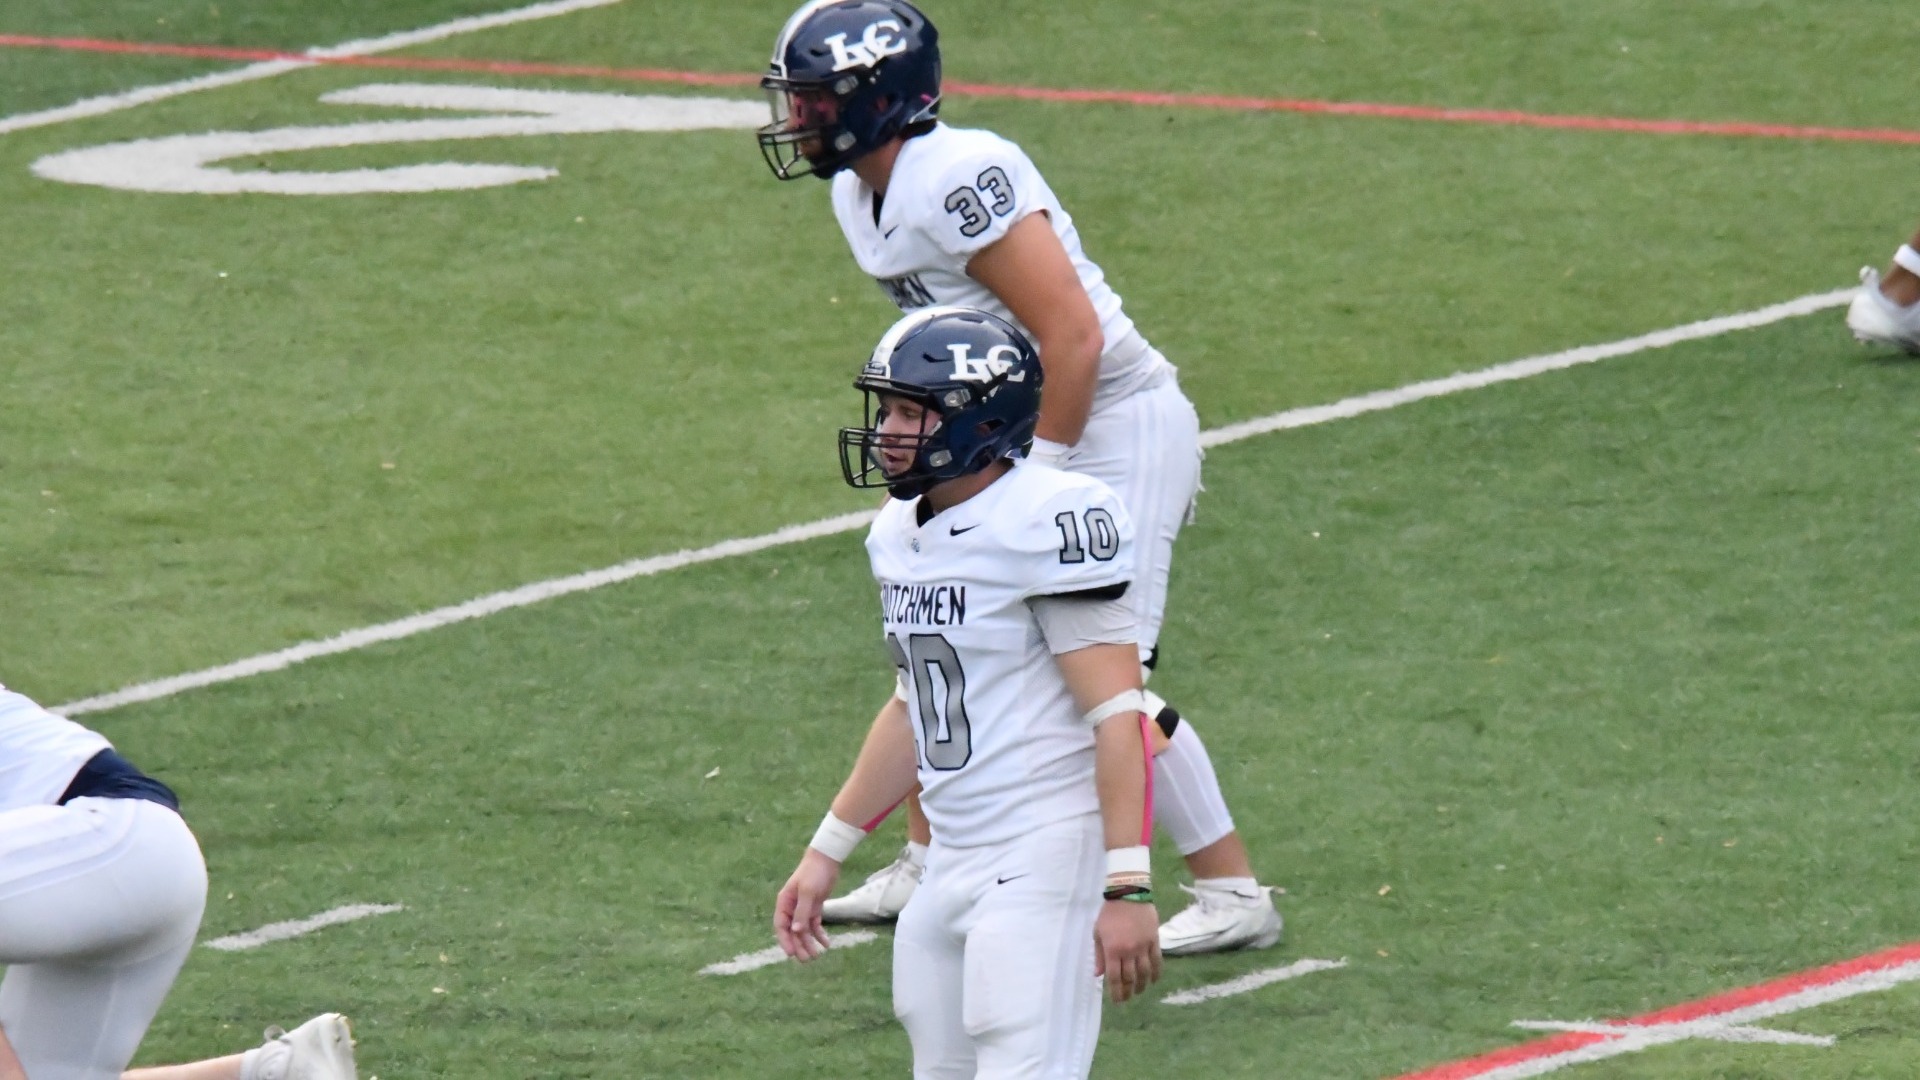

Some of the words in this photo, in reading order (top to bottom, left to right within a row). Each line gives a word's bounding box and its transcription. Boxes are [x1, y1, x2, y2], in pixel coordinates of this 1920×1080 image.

[945, 166, 1015, 237] 33
[1055, 508, 1119, 564] 10
[882, 584, 966, 625] UTCHMEN
